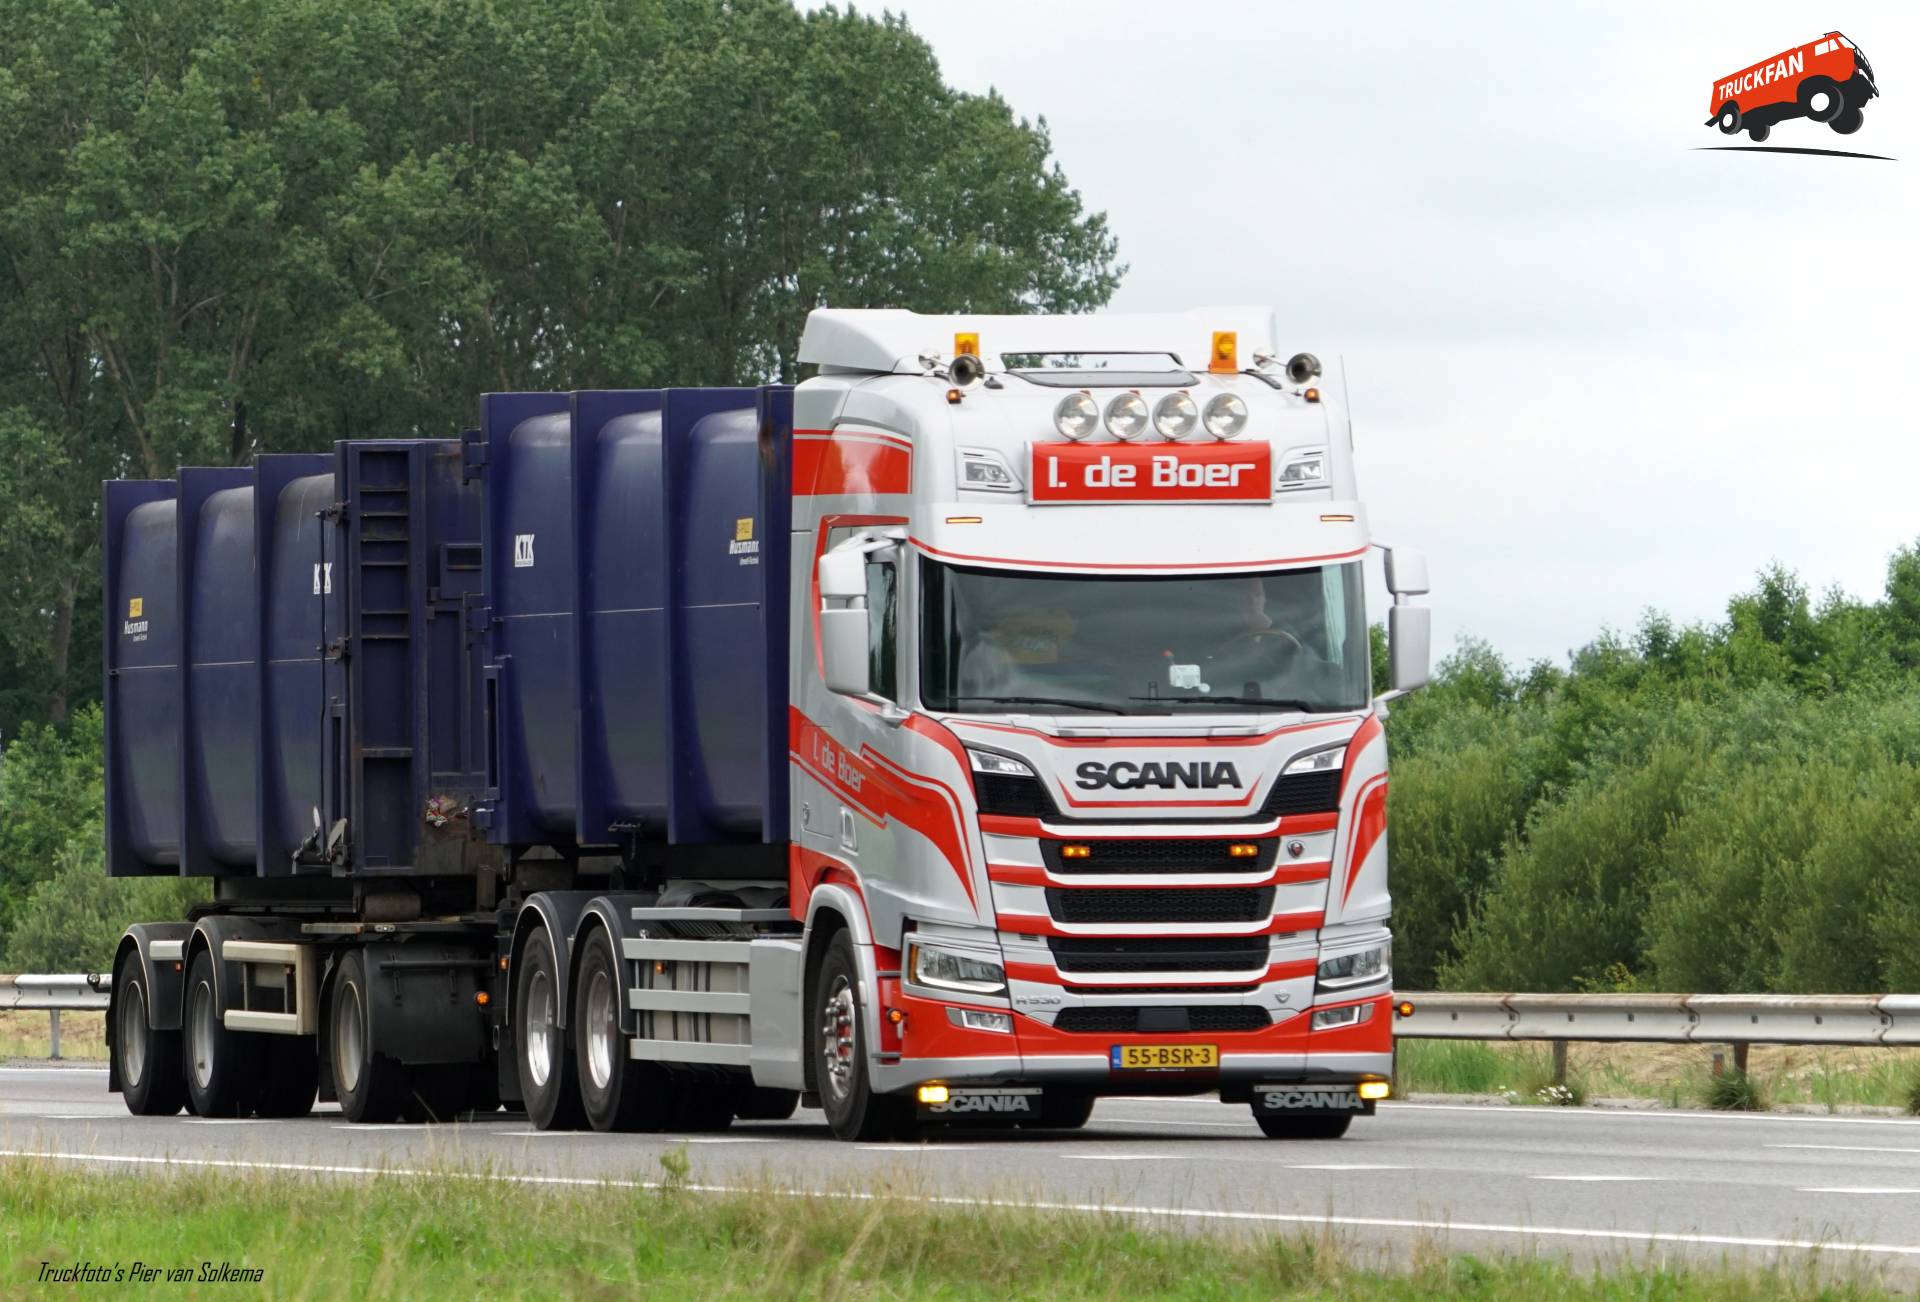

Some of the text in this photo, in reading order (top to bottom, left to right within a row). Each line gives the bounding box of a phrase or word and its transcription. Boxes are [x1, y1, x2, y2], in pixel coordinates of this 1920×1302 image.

[1084, 456, 1137, 488] de
[1152, 455, 1256, 488] Boer
[515, 534, 535, 561] KTK
[313, 562, 333, 590] KK
[822, 740, 836, 773] de
[838, 750, 866, 793] Boer
[1075, 761, 1243, 790] SCANIA
[1128, 1048, 1211, 1065] 55-BSR-3
[1264, 1092, 1365, 1109] SCANIA
